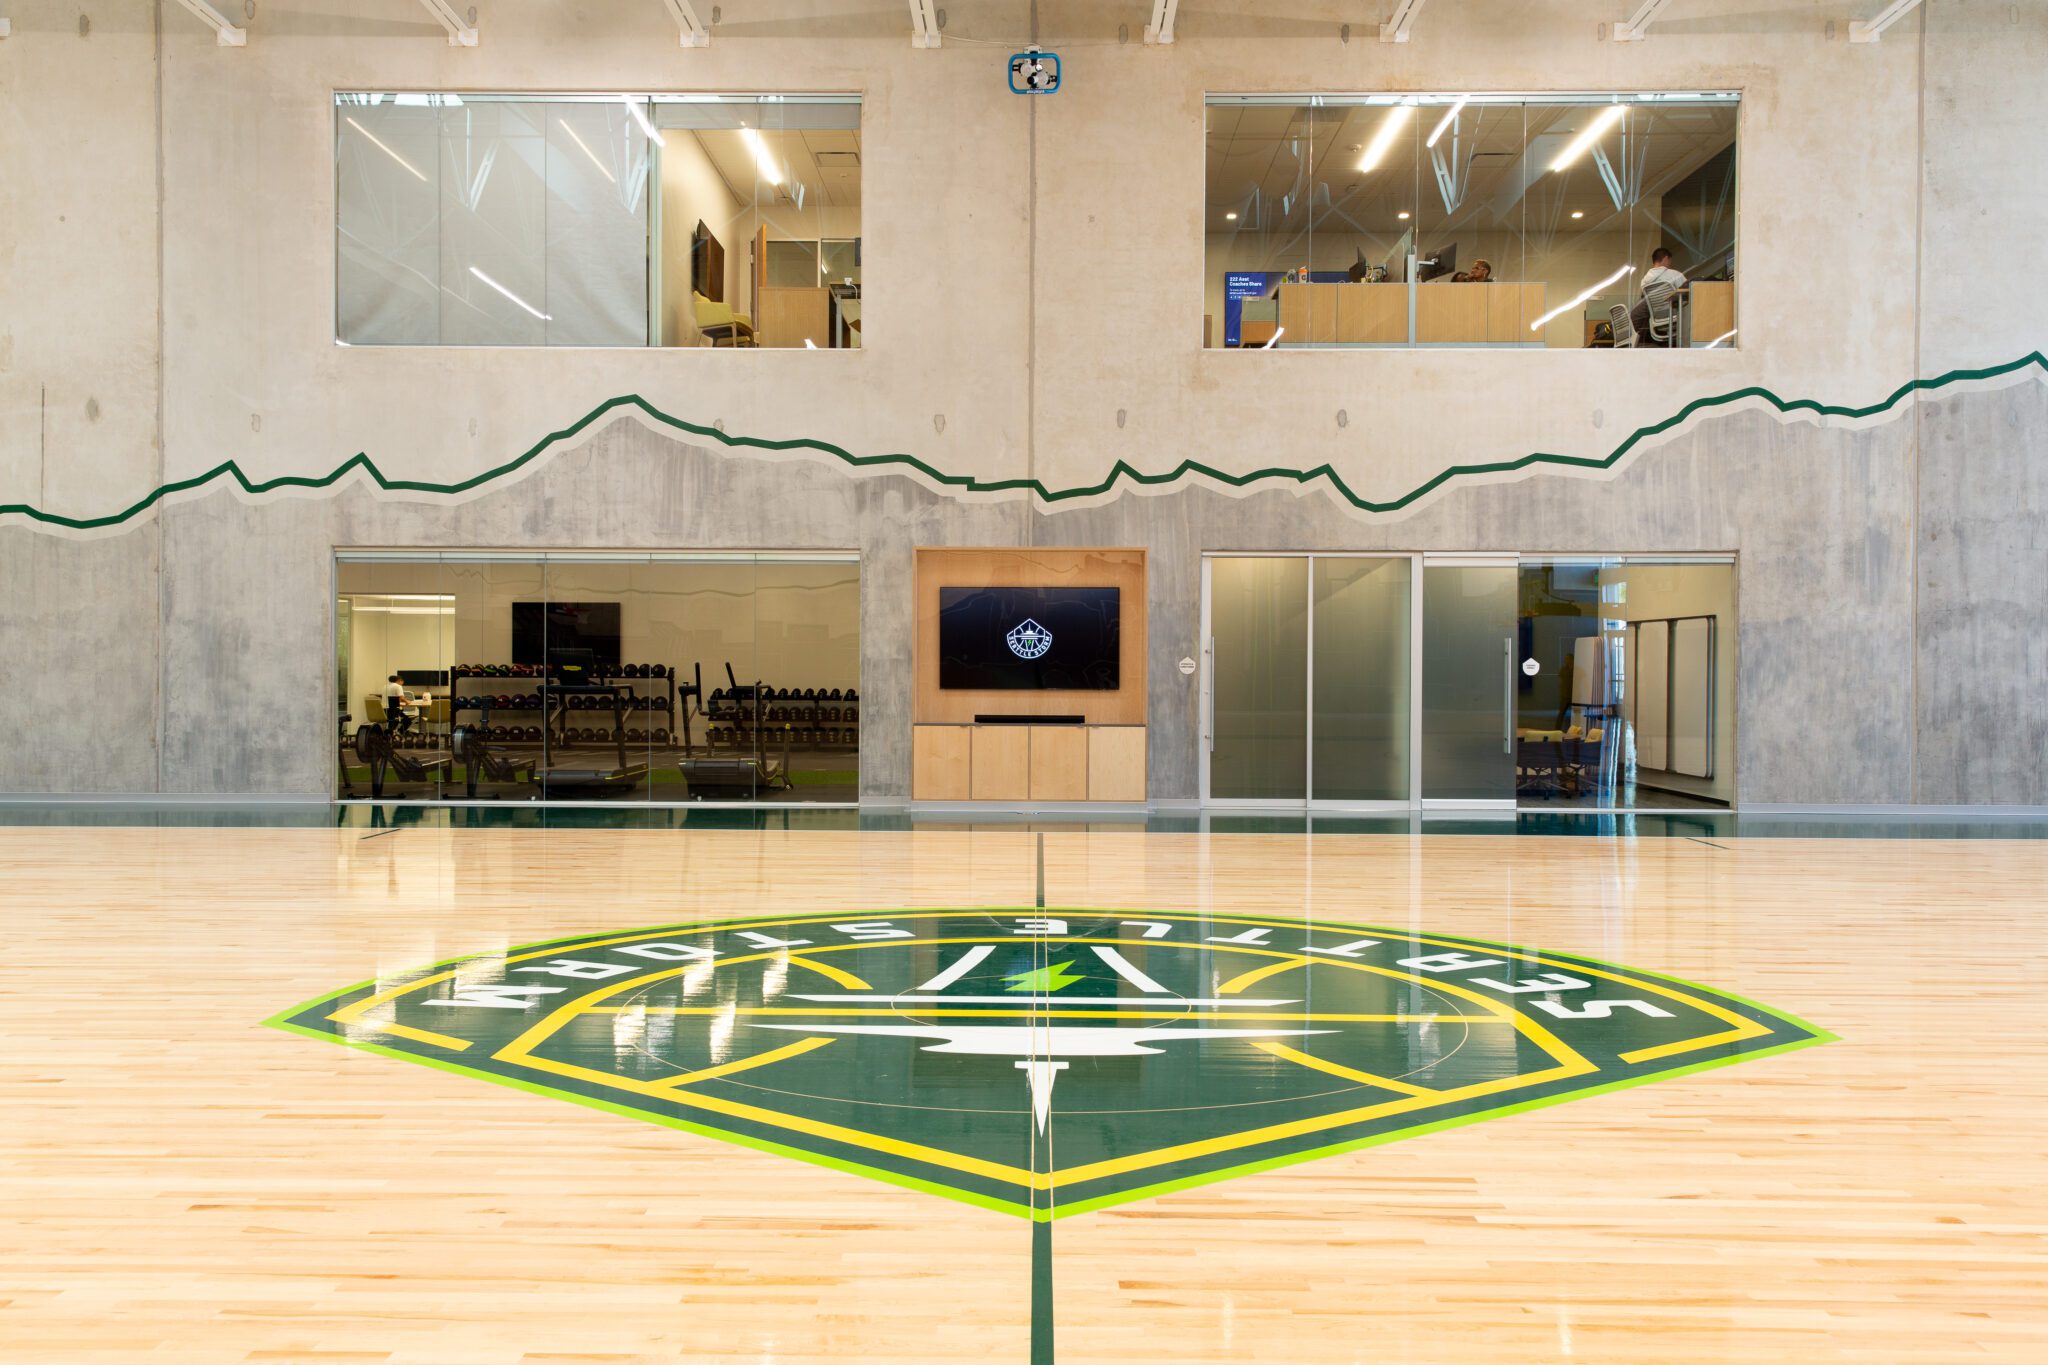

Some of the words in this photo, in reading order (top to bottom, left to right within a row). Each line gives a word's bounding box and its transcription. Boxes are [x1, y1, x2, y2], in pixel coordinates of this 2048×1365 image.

[1008, 635, 1032, 657] SEATTLE
[1034, 636, 1051, 656] STORM
[420, 921, 916, 1010] STORM
[1013, 917, 1678, 1019] SEATTLE
